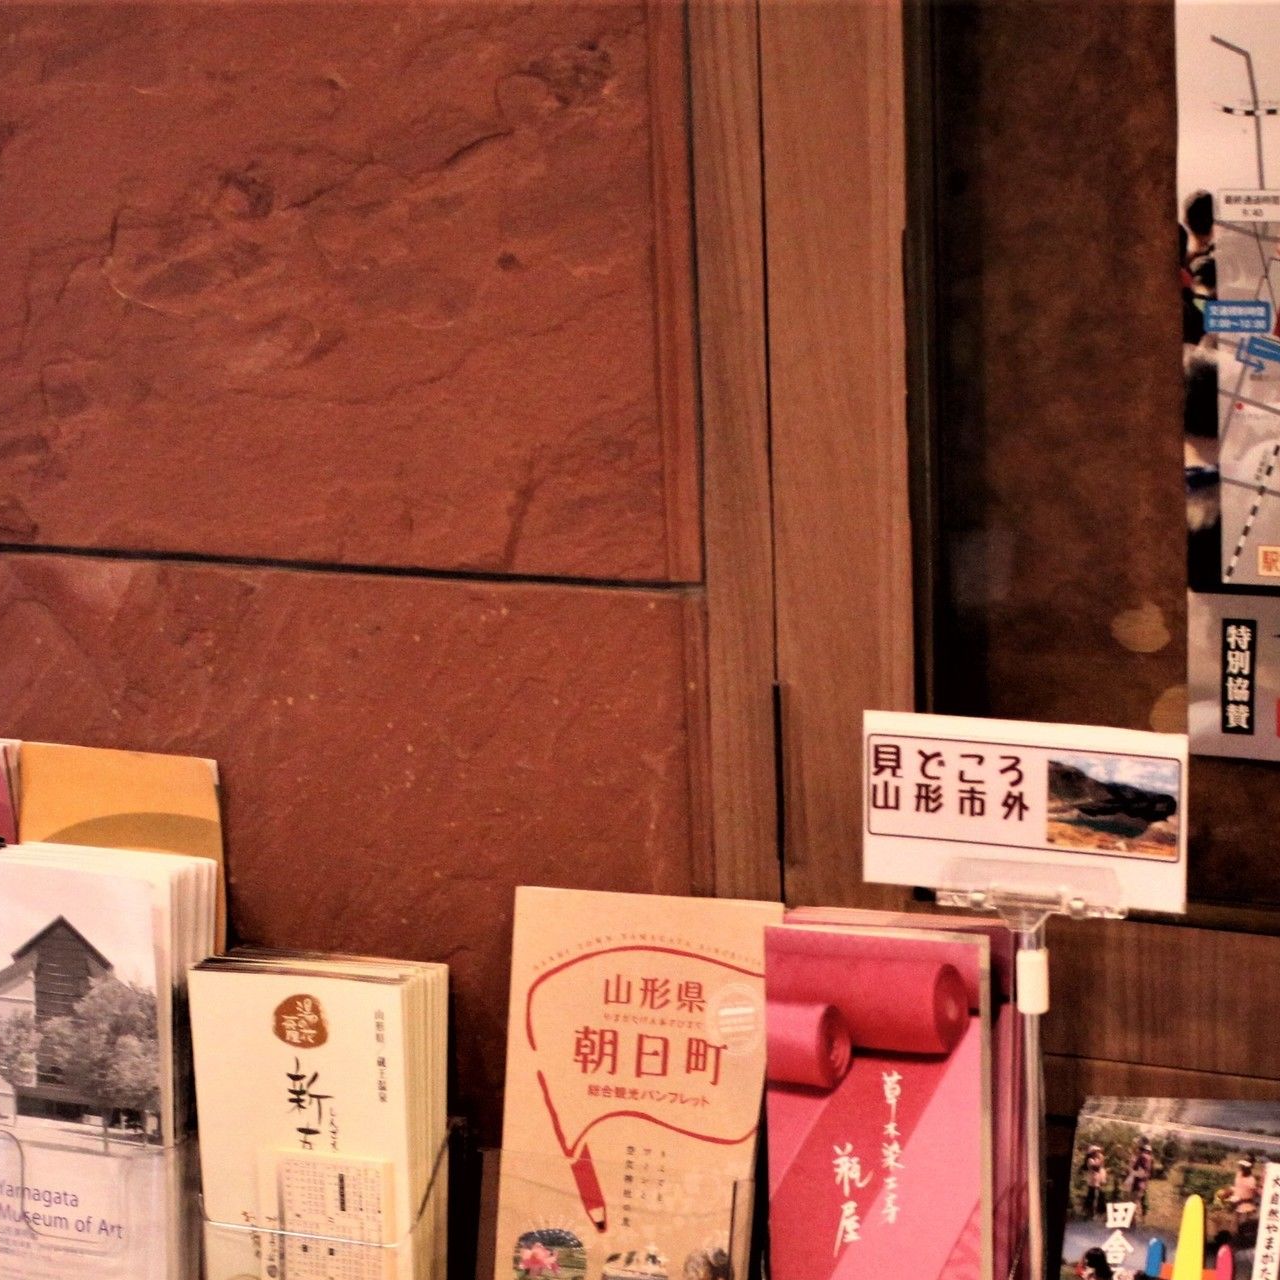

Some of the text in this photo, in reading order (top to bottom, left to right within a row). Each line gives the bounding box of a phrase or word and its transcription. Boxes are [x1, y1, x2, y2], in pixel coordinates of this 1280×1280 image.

[1225, 623, 1253, 731] 特別協賛
[871, 743, 1023, 787] 見どころ
[871, 780, 1030, 822] 山形市外
[603, 973, 709, 1014] 山形県
[572, 1024, 730, 1087] 朝日町
[587, 1083, 711, 1106] 総合観光パンフレット
[73, 1210, 94, 1232] of
[97, 1217, 125, 1242] Art
